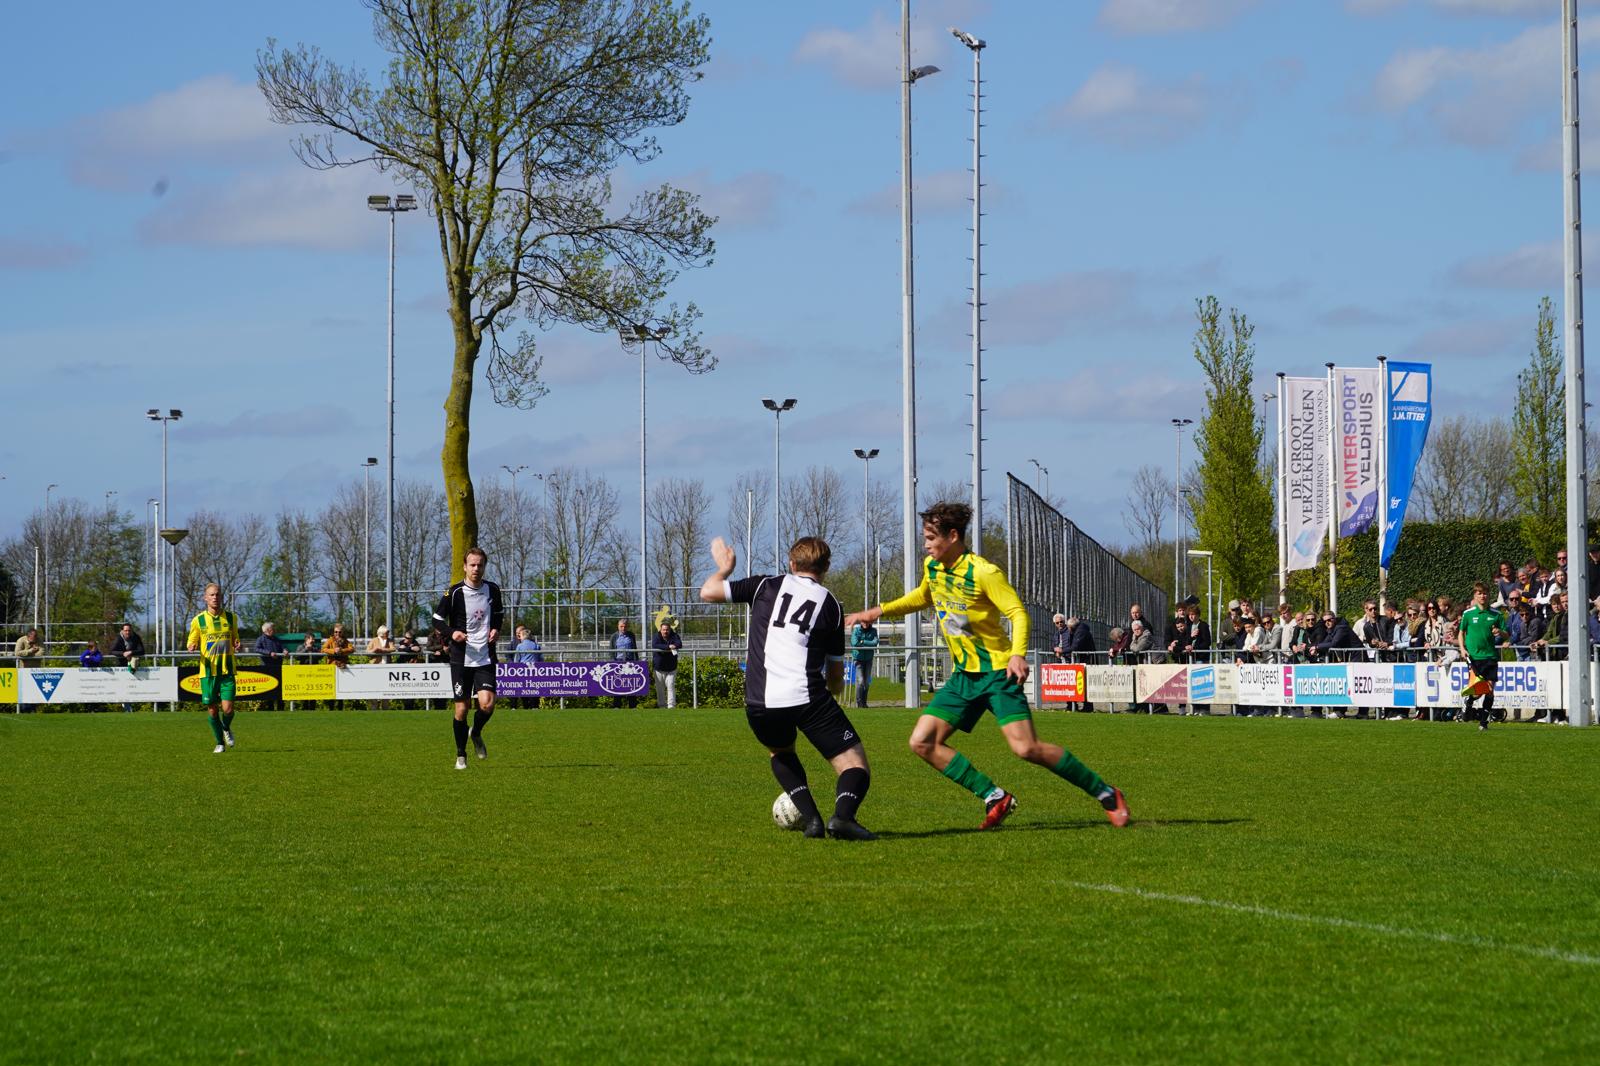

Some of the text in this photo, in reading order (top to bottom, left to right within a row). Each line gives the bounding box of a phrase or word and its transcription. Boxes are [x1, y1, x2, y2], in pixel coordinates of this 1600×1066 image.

[1343, 375, 1358, 489] INTERSPORT
[1360, 392, 1373, 485] VELDHUIS
[1291, 414, 1302, 500] DE GROOT
[1302, 389, 1314, 525] VERZEKERINGEN
[773, 592, 817, 635] 14
[389, 671, 440, 681] NR. 10
[495, 663, 588, 678] bloemenshop
[496, 680, 523, 688] Yvonne
[1253, 666, 1280, 690] Uitgeest
[1354, 676, 1373, 694] BEZO
